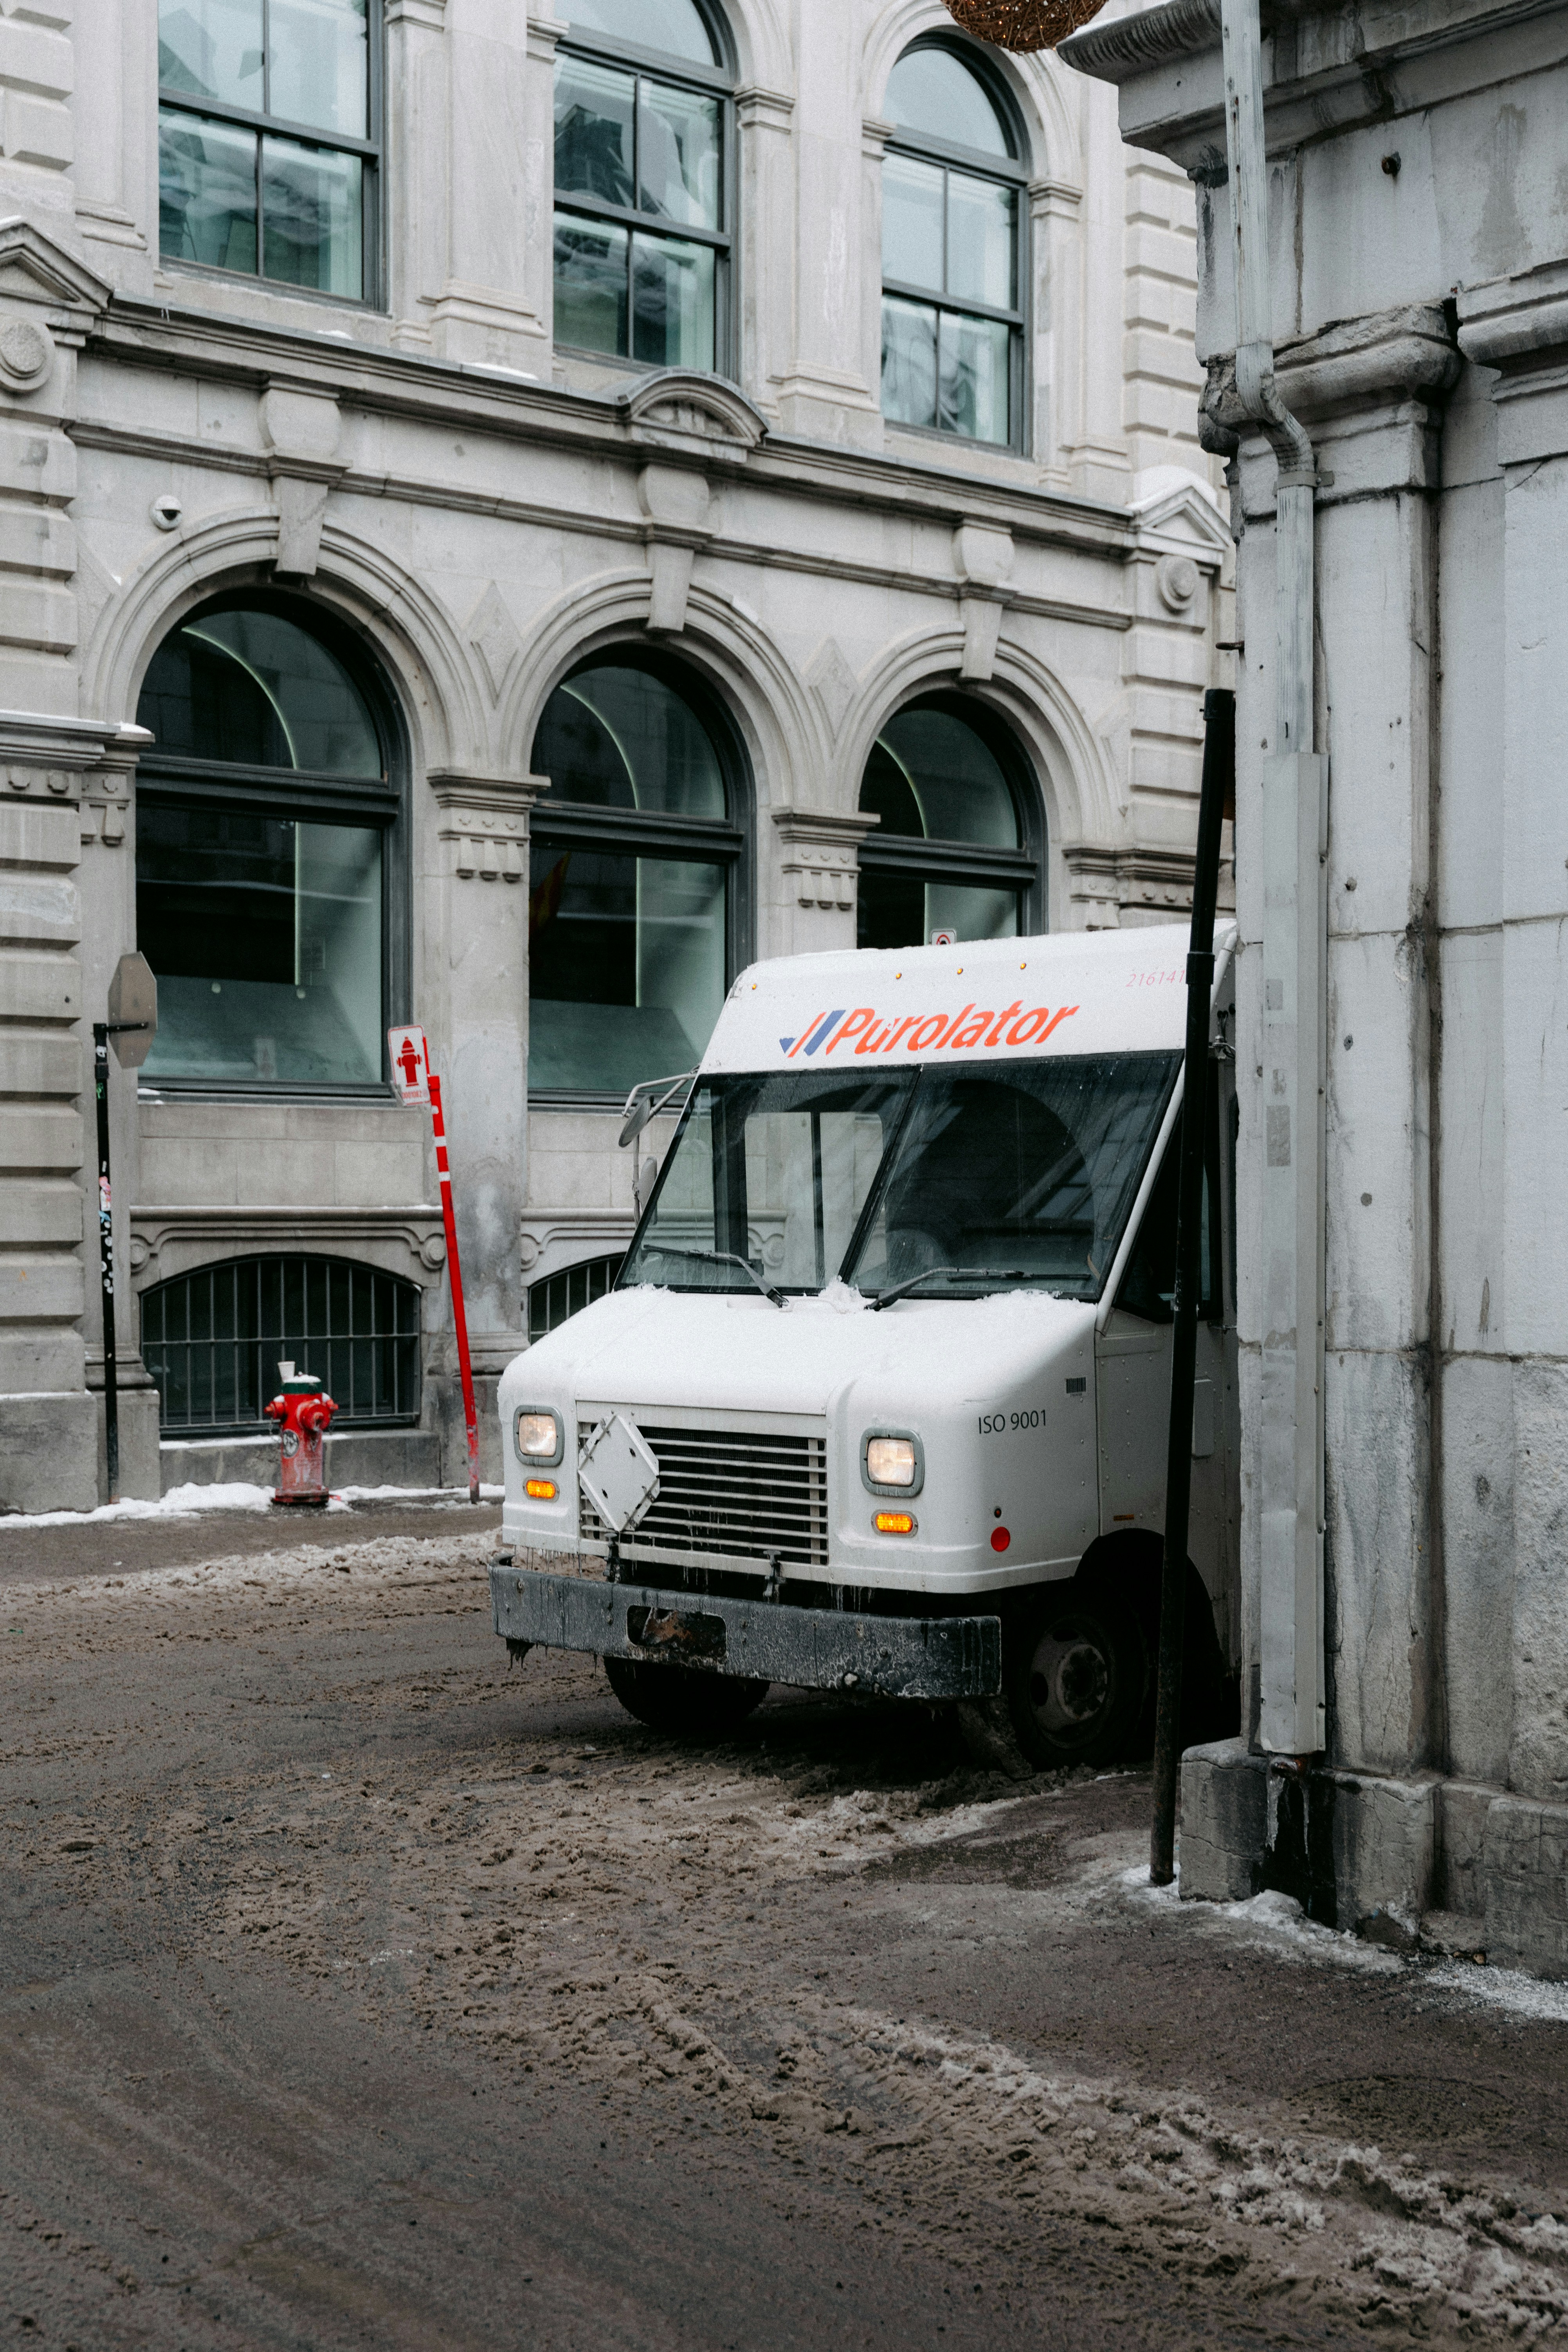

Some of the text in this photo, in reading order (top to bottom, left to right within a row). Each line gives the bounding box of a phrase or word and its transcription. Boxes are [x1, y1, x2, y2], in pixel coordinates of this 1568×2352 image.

[1125, 968, 1185, 988] 216141
[825, 1000, 1080, 1056] Purolator
[978, 1409, 1046, 1434] ISO 9001
